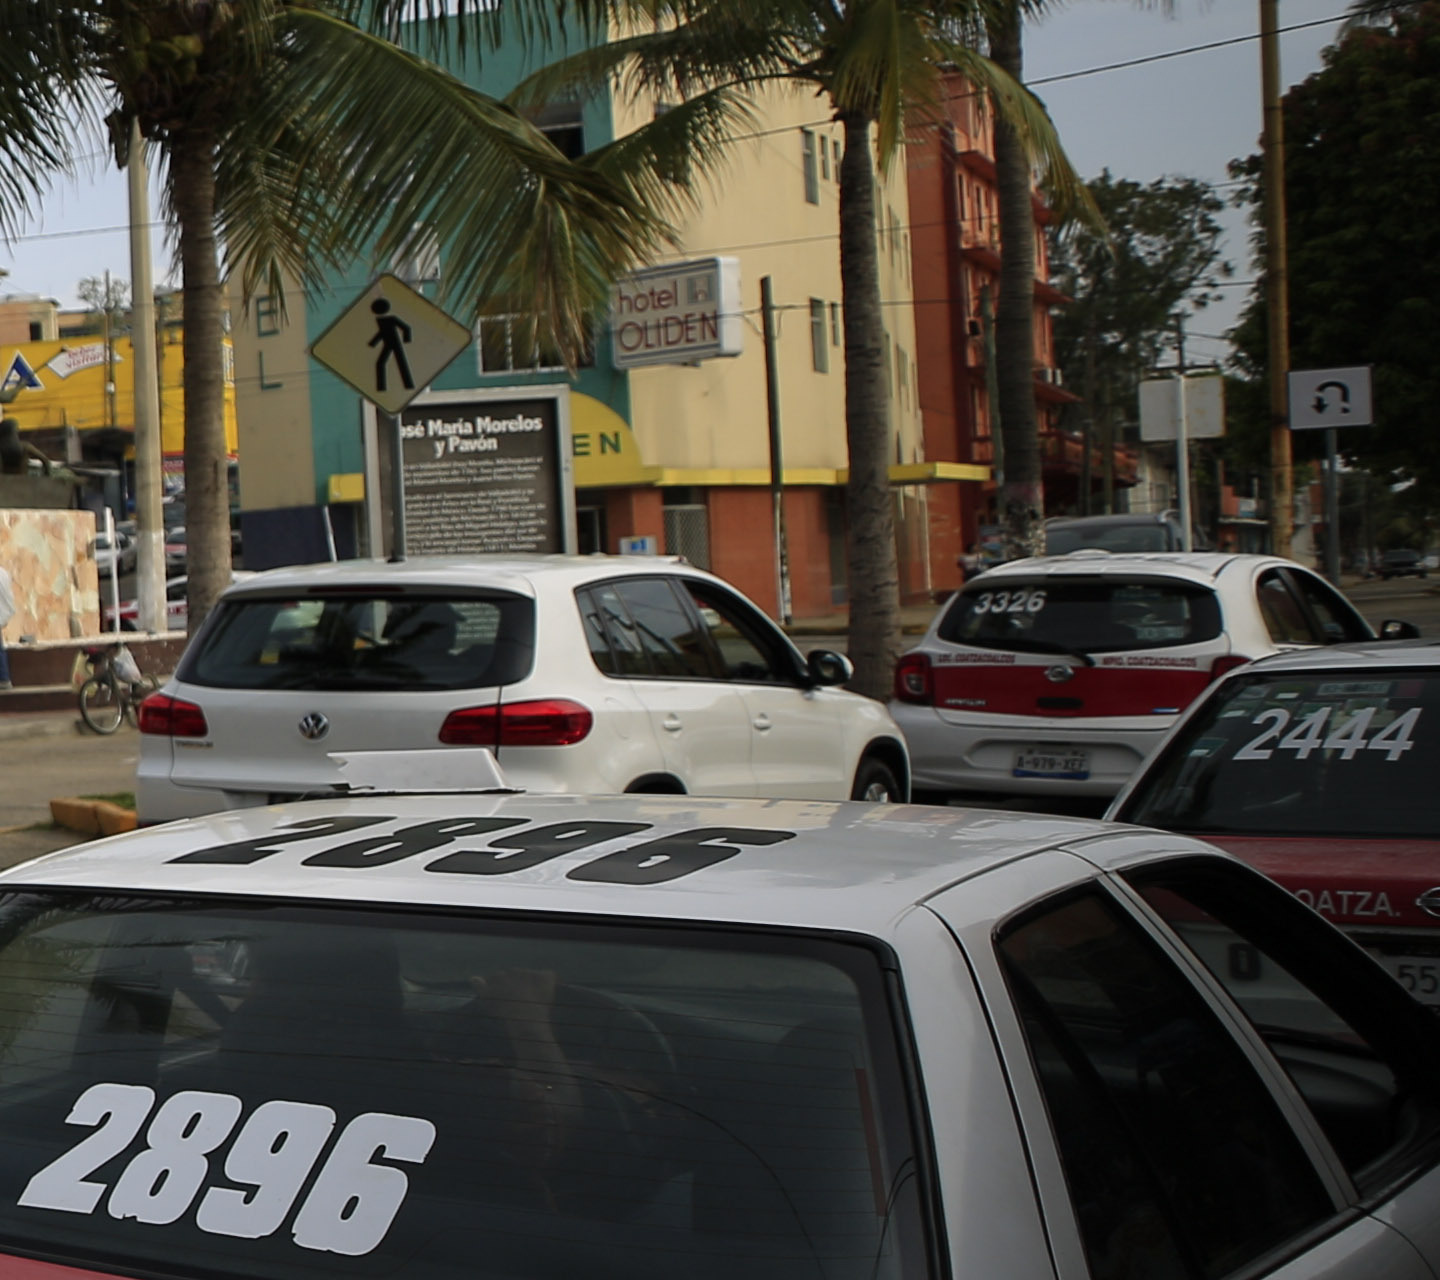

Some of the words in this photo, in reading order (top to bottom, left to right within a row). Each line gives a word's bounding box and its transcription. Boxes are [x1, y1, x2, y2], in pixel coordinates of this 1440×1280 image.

[618, 281, 678, 314] hotel
[620, 309, 718, 351] OLIDEN
[428, 418, 474, 437] María
[476, 414, 543, 434] Morelos
[434, 439, 446, 458] y
[448, 433, 499, 453] Pavón
[974, 590, 1047, 615] 3326
[1232, 707, 1423, 761] 2444
[164, 817, 797, 886] 2896
[1291, 889, 1401, 918] OATZA.
[17, 1083, 437, 1256] 2896
